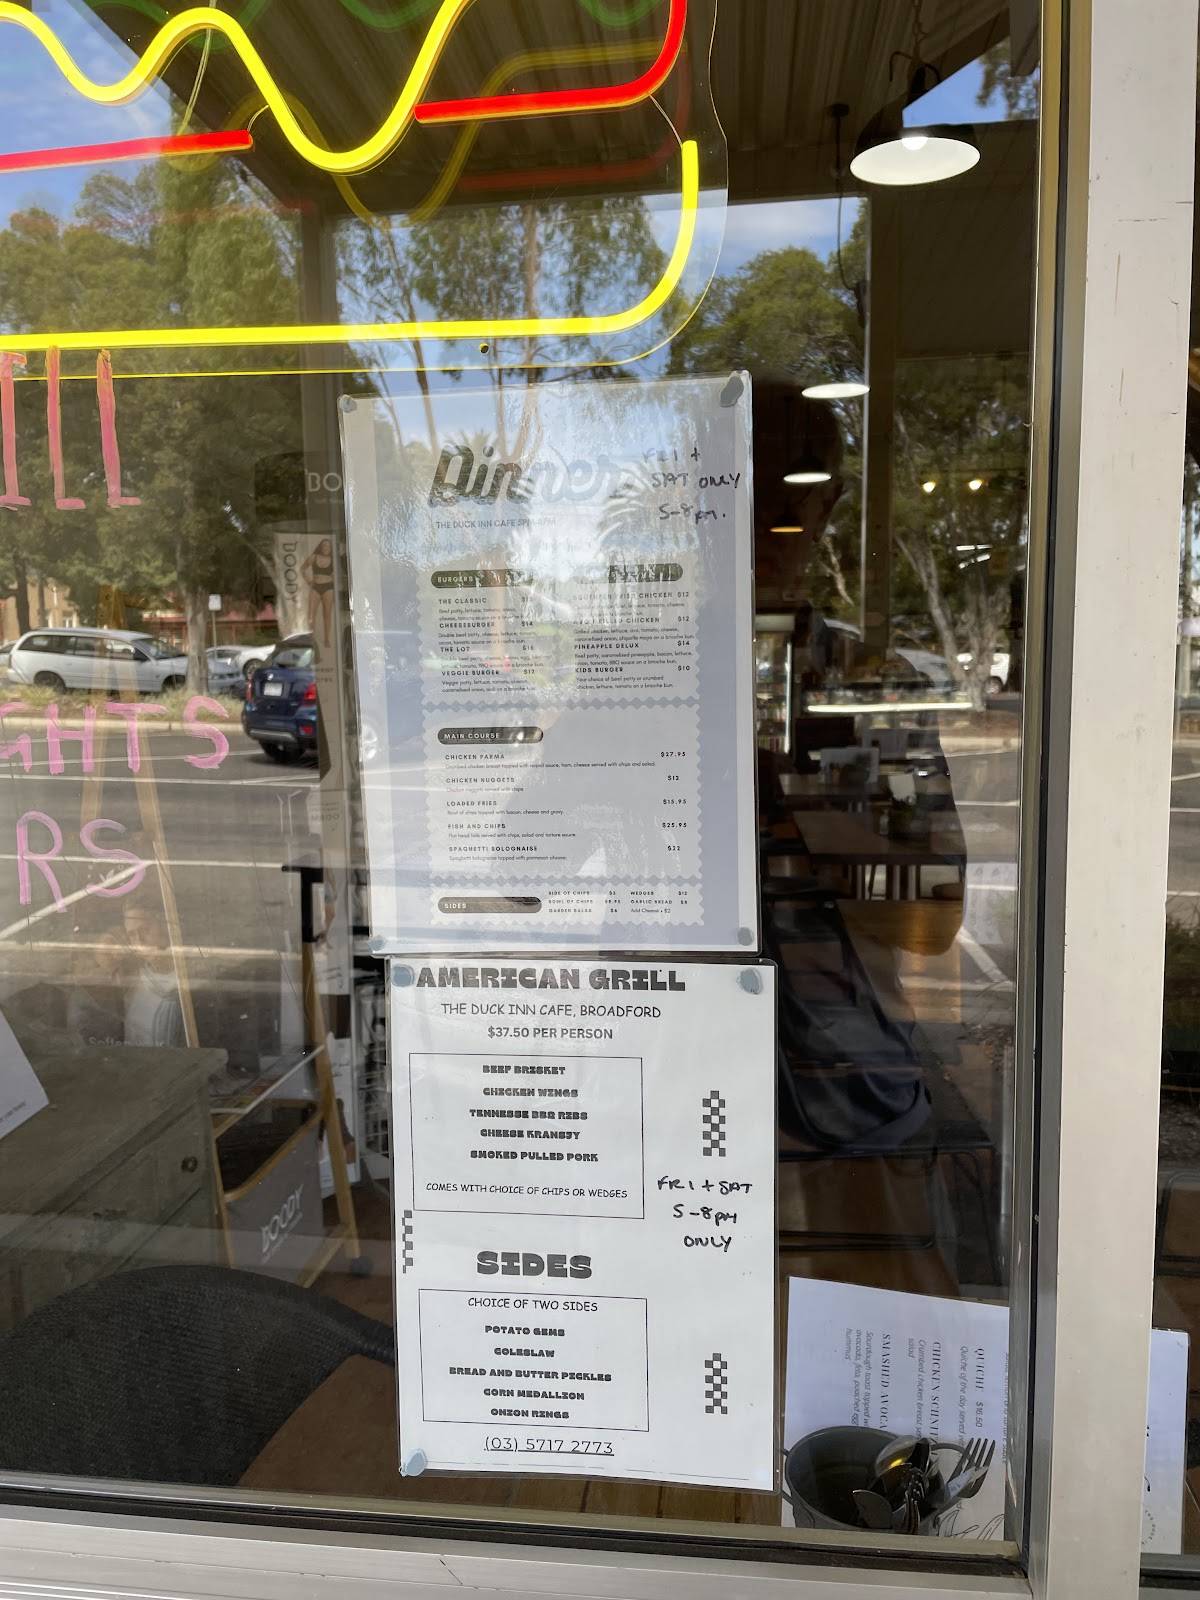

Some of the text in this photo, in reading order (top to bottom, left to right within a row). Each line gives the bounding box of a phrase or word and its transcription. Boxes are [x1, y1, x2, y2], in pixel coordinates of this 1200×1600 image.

[453, 520, 476, 529] DUCK
[416, 966, 686, 992] AMERICAN GRILL
[441, 1003, 661, 1019] THE DUCK INN CAFE, BROADFORD
[487, 1025, 613, 1039] $37.50 PER PERSON
[482, 1065, 566, 1075] BEEF BRISKET
[483, 1087, 578, 1097] CHICKEN WINGS
[531, 1111, 556, 1120] BBQ
[558, 1111, 588, 1120] RIBS
[480, 1129, 524, 1138] CHEESE
[470, 1150, 599, 1162] SMOKED PULLED PORK
[425, 1183, 628, 1198] COMES WITH CHOICE OF CHIPS OR WEDGES
[701, 1178, 715, 1193] +
[683, 1235, 732, 1252] ONLY
[476, 1250, 593, 1280] SIDES
[468, 1297, 598, 1312] CHOICE OF TWO SIDES
[484, 1325, 565, 1337] POTATO GEMS
[493, 1347, 555, 1358] COLESLAW
[931, 1341, 941, 1391] CHICKEN
[974, 1348, 985, 1392] QUICHE
[449, 1366, 612, 1382] BREAD AND BUTTER PICKLES
[879, 1333, 891, 1429] SMASHED AVOCA
[483, 1388, 585, 1401] CORN MEDALLION
[490, 1408, 570, 1419] ONION RINGS
[485, 1436, 614, 1454] (03) 5717 2773
